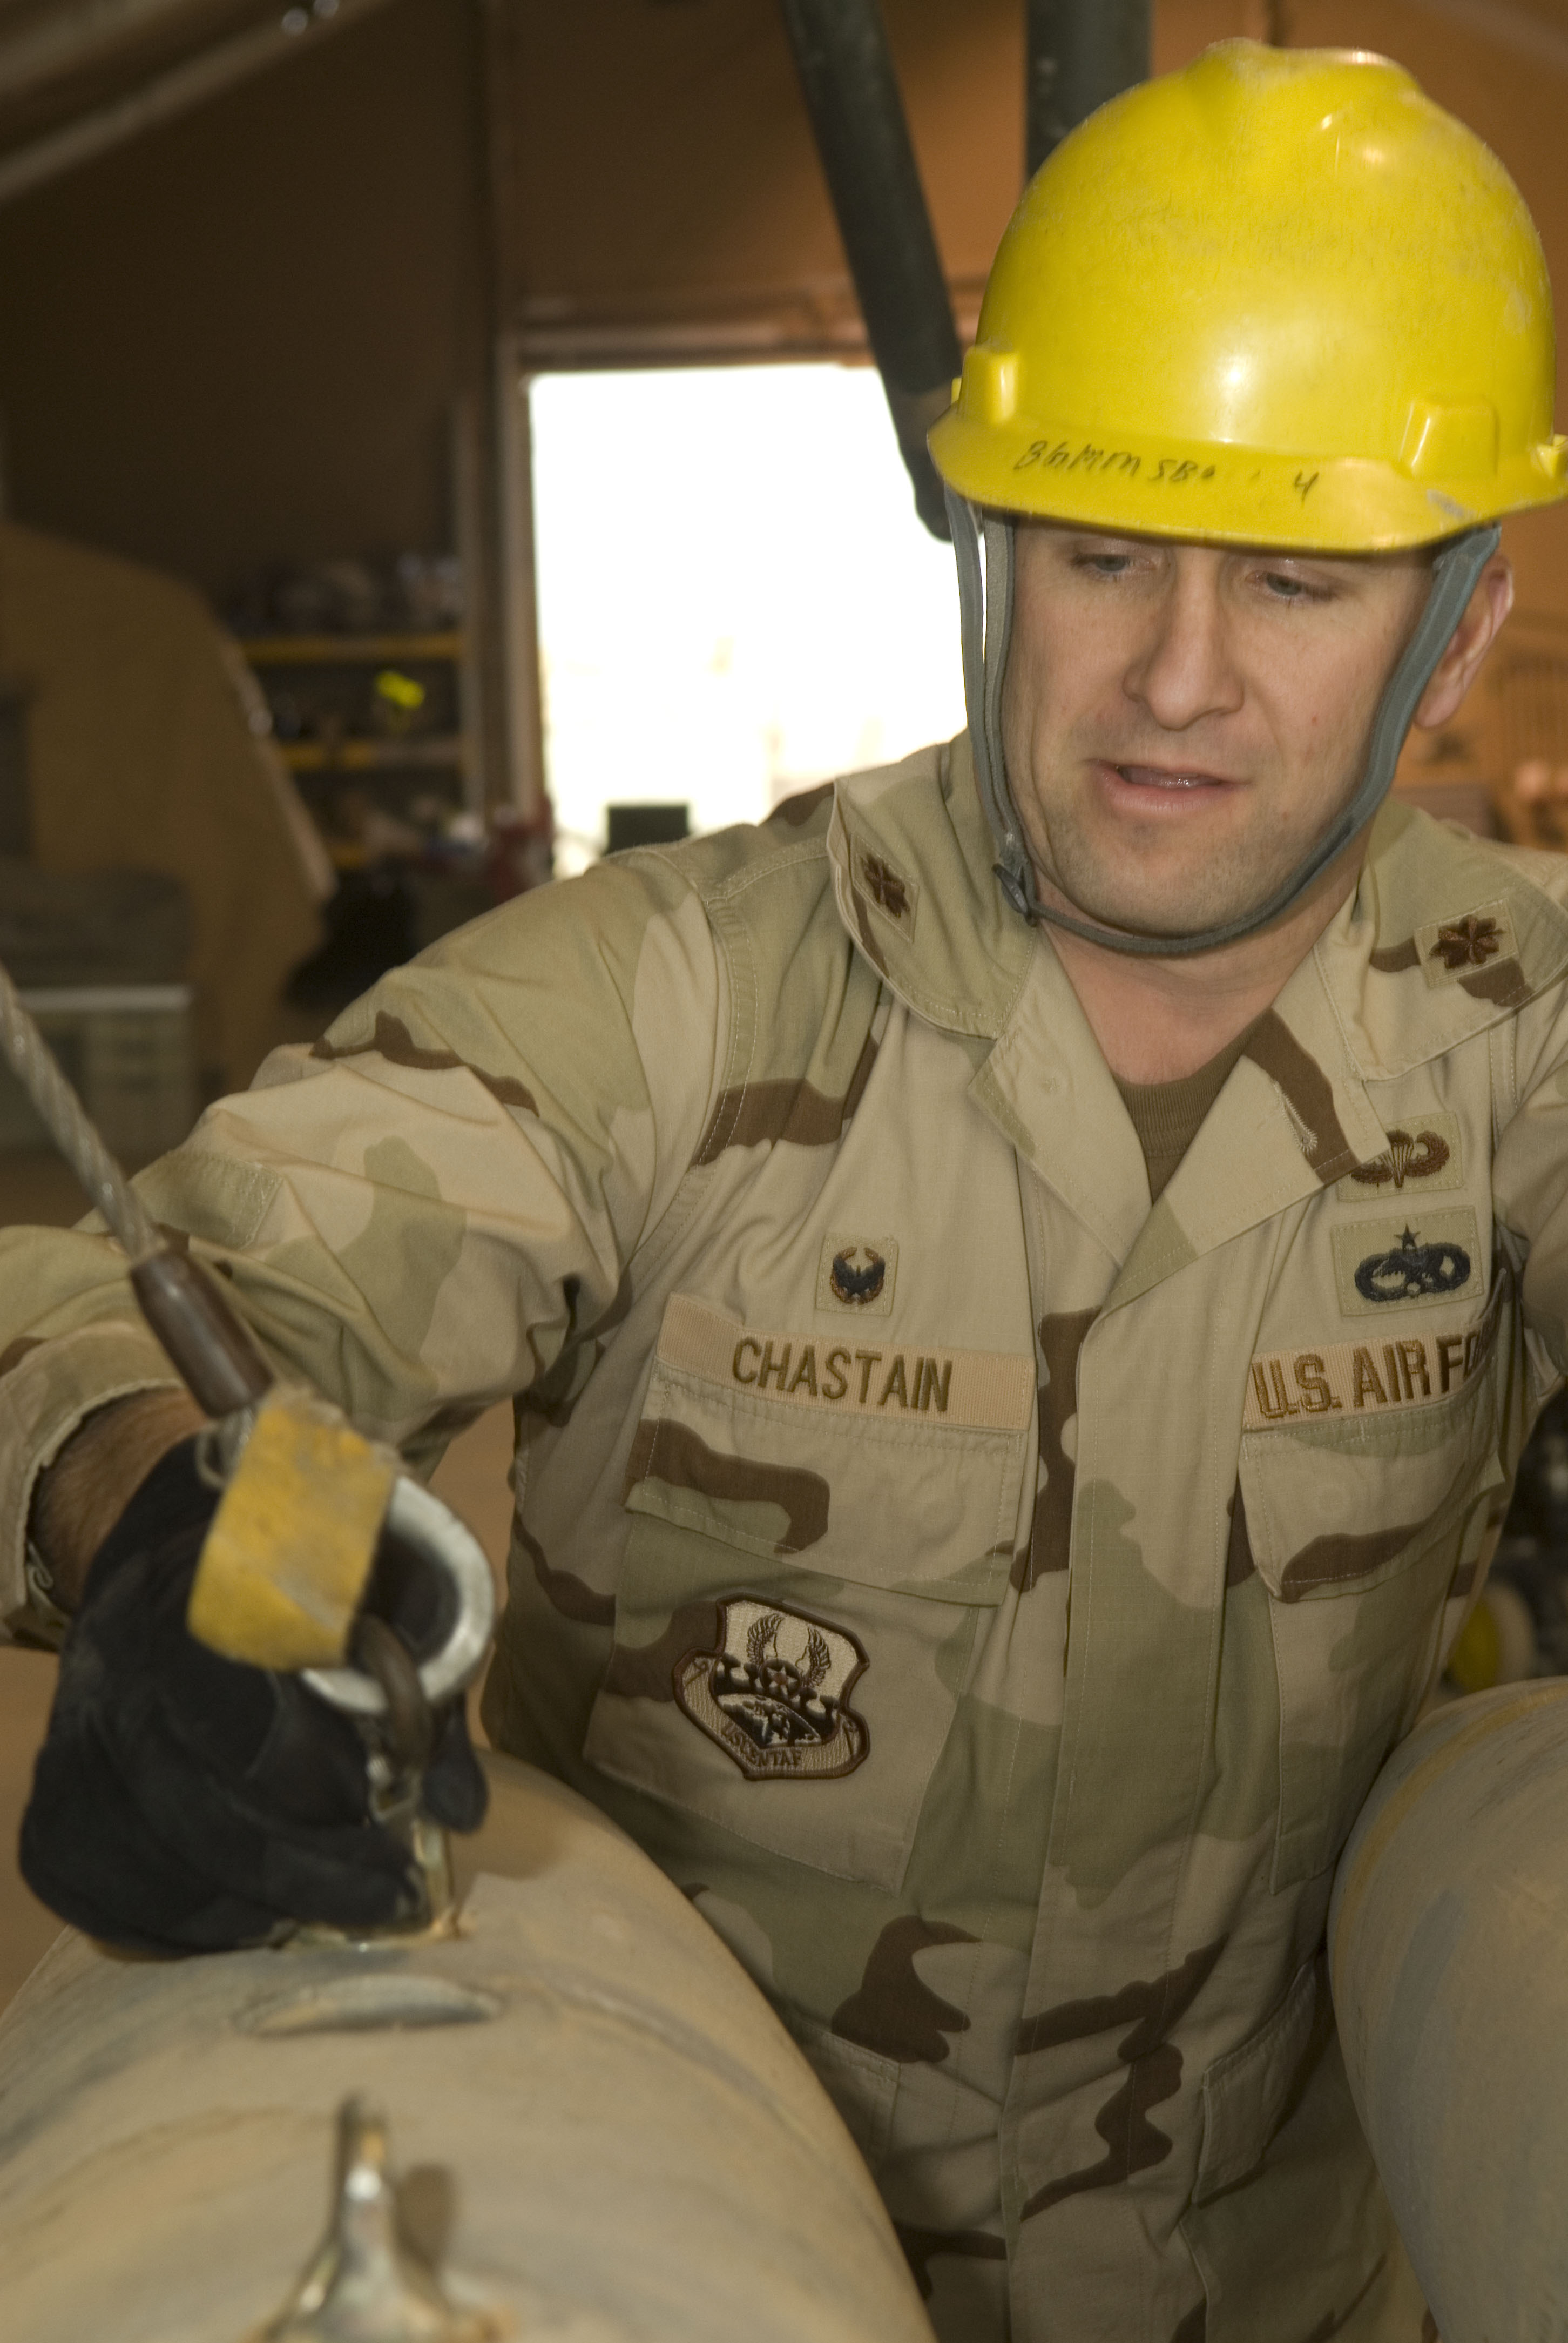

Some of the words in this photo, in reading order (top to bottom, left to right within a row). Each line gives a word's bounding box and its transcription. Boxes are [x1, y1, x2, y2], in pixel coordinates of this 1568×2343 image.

[733, 1337, 952, 1412] CHASTAIN
[1252, 1354, 1342, 1418] U.S.
[1353, 1339, 1431, 1407] AIR
